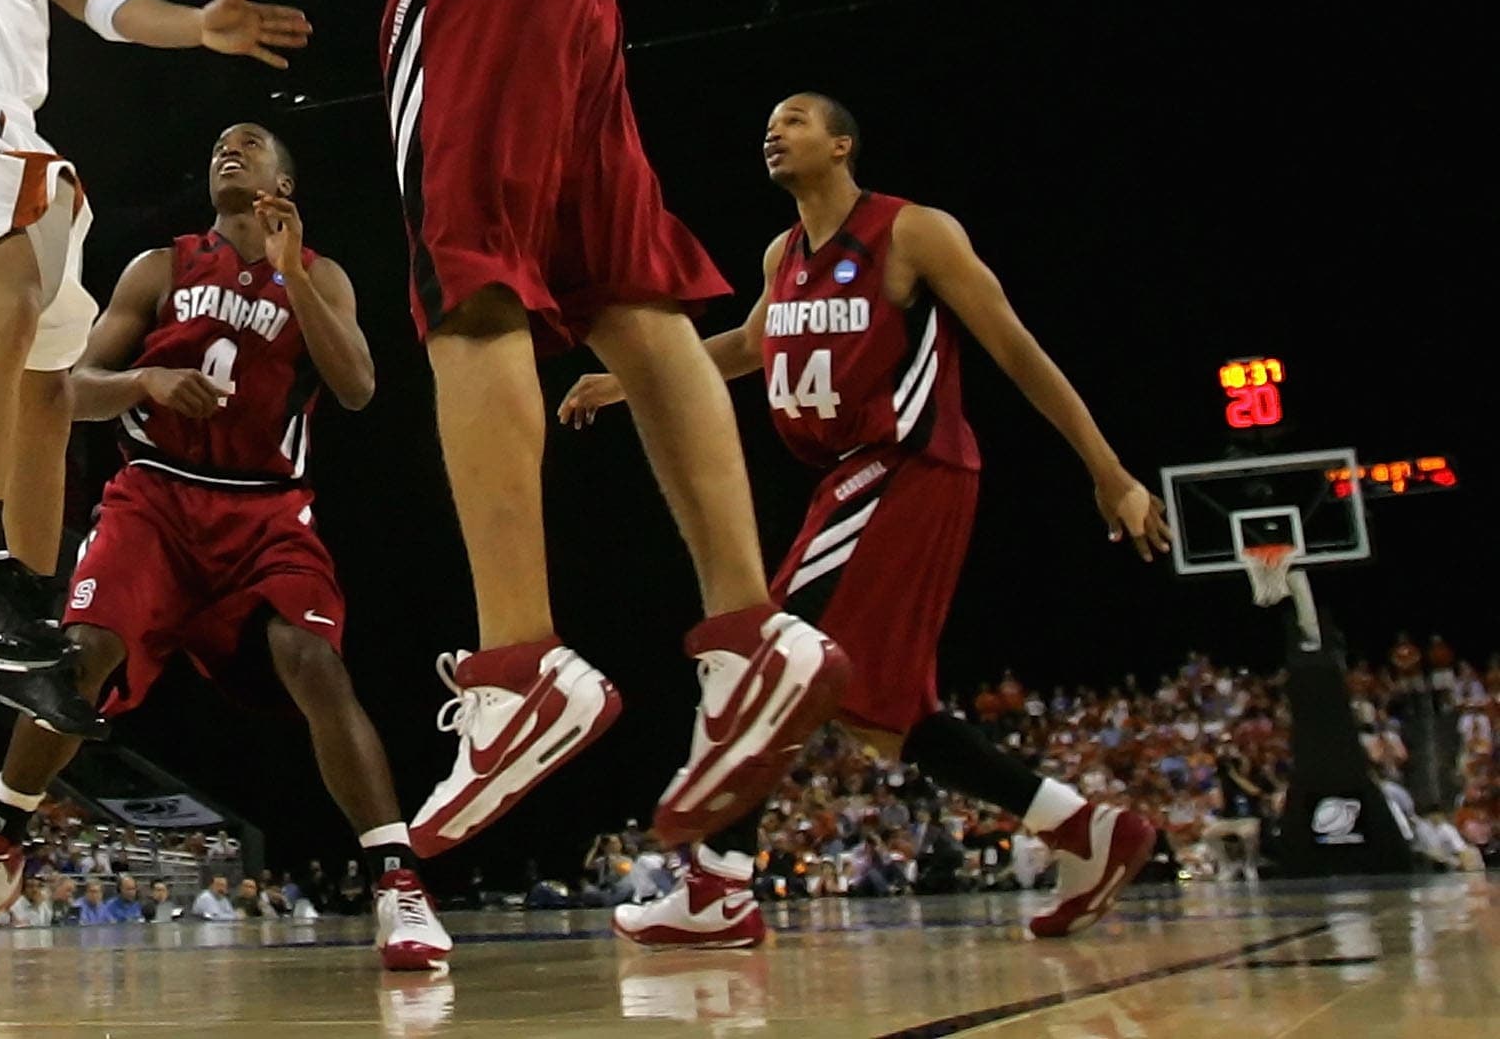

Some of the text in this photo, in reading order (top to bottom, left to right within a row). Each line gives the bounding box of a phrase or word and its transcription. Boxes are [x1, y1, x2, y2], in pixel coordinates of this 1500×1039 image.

[200, 337, 238, 407] 4
[768, 349, 841, 419] 44
[1225, 383, 1284, 428] 20
[70, 577, 97, 610] S
